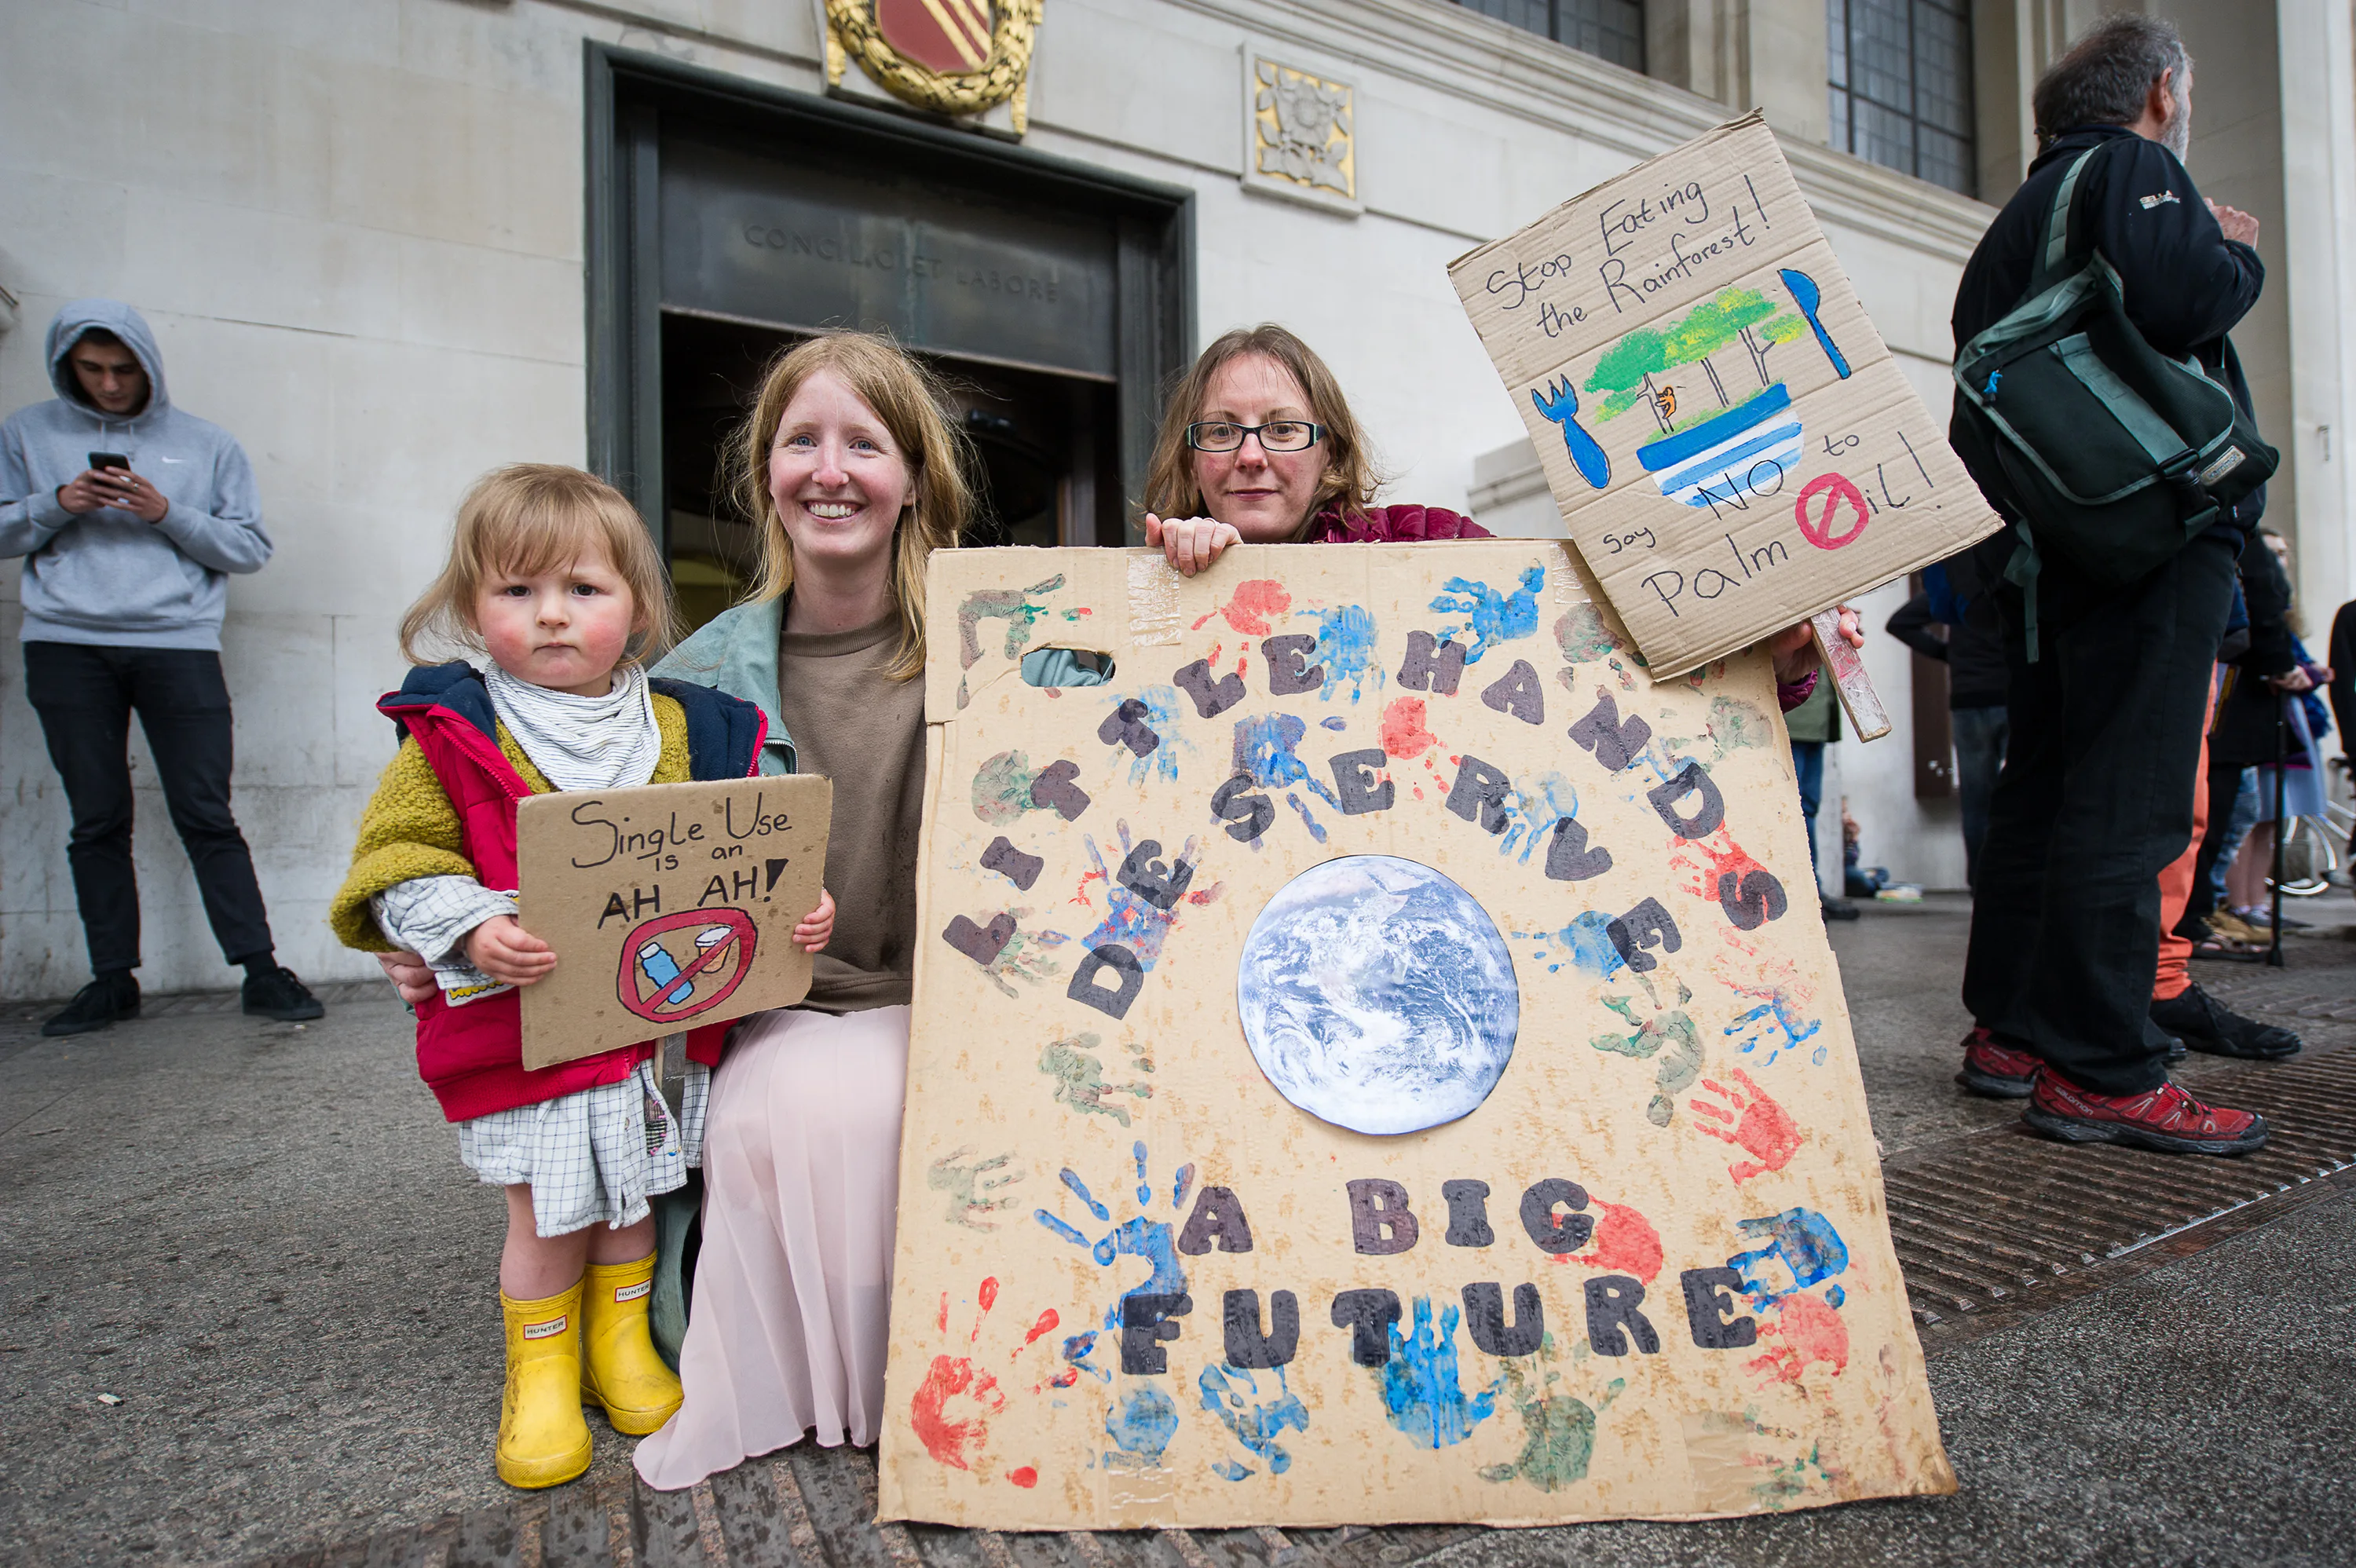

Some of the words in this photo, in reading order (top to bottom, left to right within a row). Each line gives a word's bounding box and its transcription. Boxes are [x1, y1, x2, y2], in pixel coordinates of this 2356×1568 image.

[913, 255, 943, 280] ET
[956, 267, 1059, 305] LABORE
[1486, 254, 1571, 310] Stop
[1599, 181, 1709, 257] Eating
[1536, 302, 1588, 338] the
[1599, 174, 1770, 313] Rainforest!
[1697, 459, 1784, 521] NO
[1823, 433, 1860, 457] to
[1641, 533, 1789, 617] Palm
[571, 800, 705, 868] Single
[725, 791, 793, 840] Use
[942, 634, 1325, 965] LITTLE
[1396, 630, 1787, 930] HANDS
[597, 884, 660, 930] AH
[697, 858, 789, 907] AH!
[655, 857, 679, 872] is
[711, 844, 743, 860] an
[1066, 748, 1682, 1020] DESERVE
[1177, 1186, 1254, 1255] A
[1345, 1178, 1595, 1255] BIG
[526, 1321, 564, 1335] HUNTER
[617, 1283, 650, 1297] HUNTER
[1120, 1266, 1758, 1375] FUTURE
